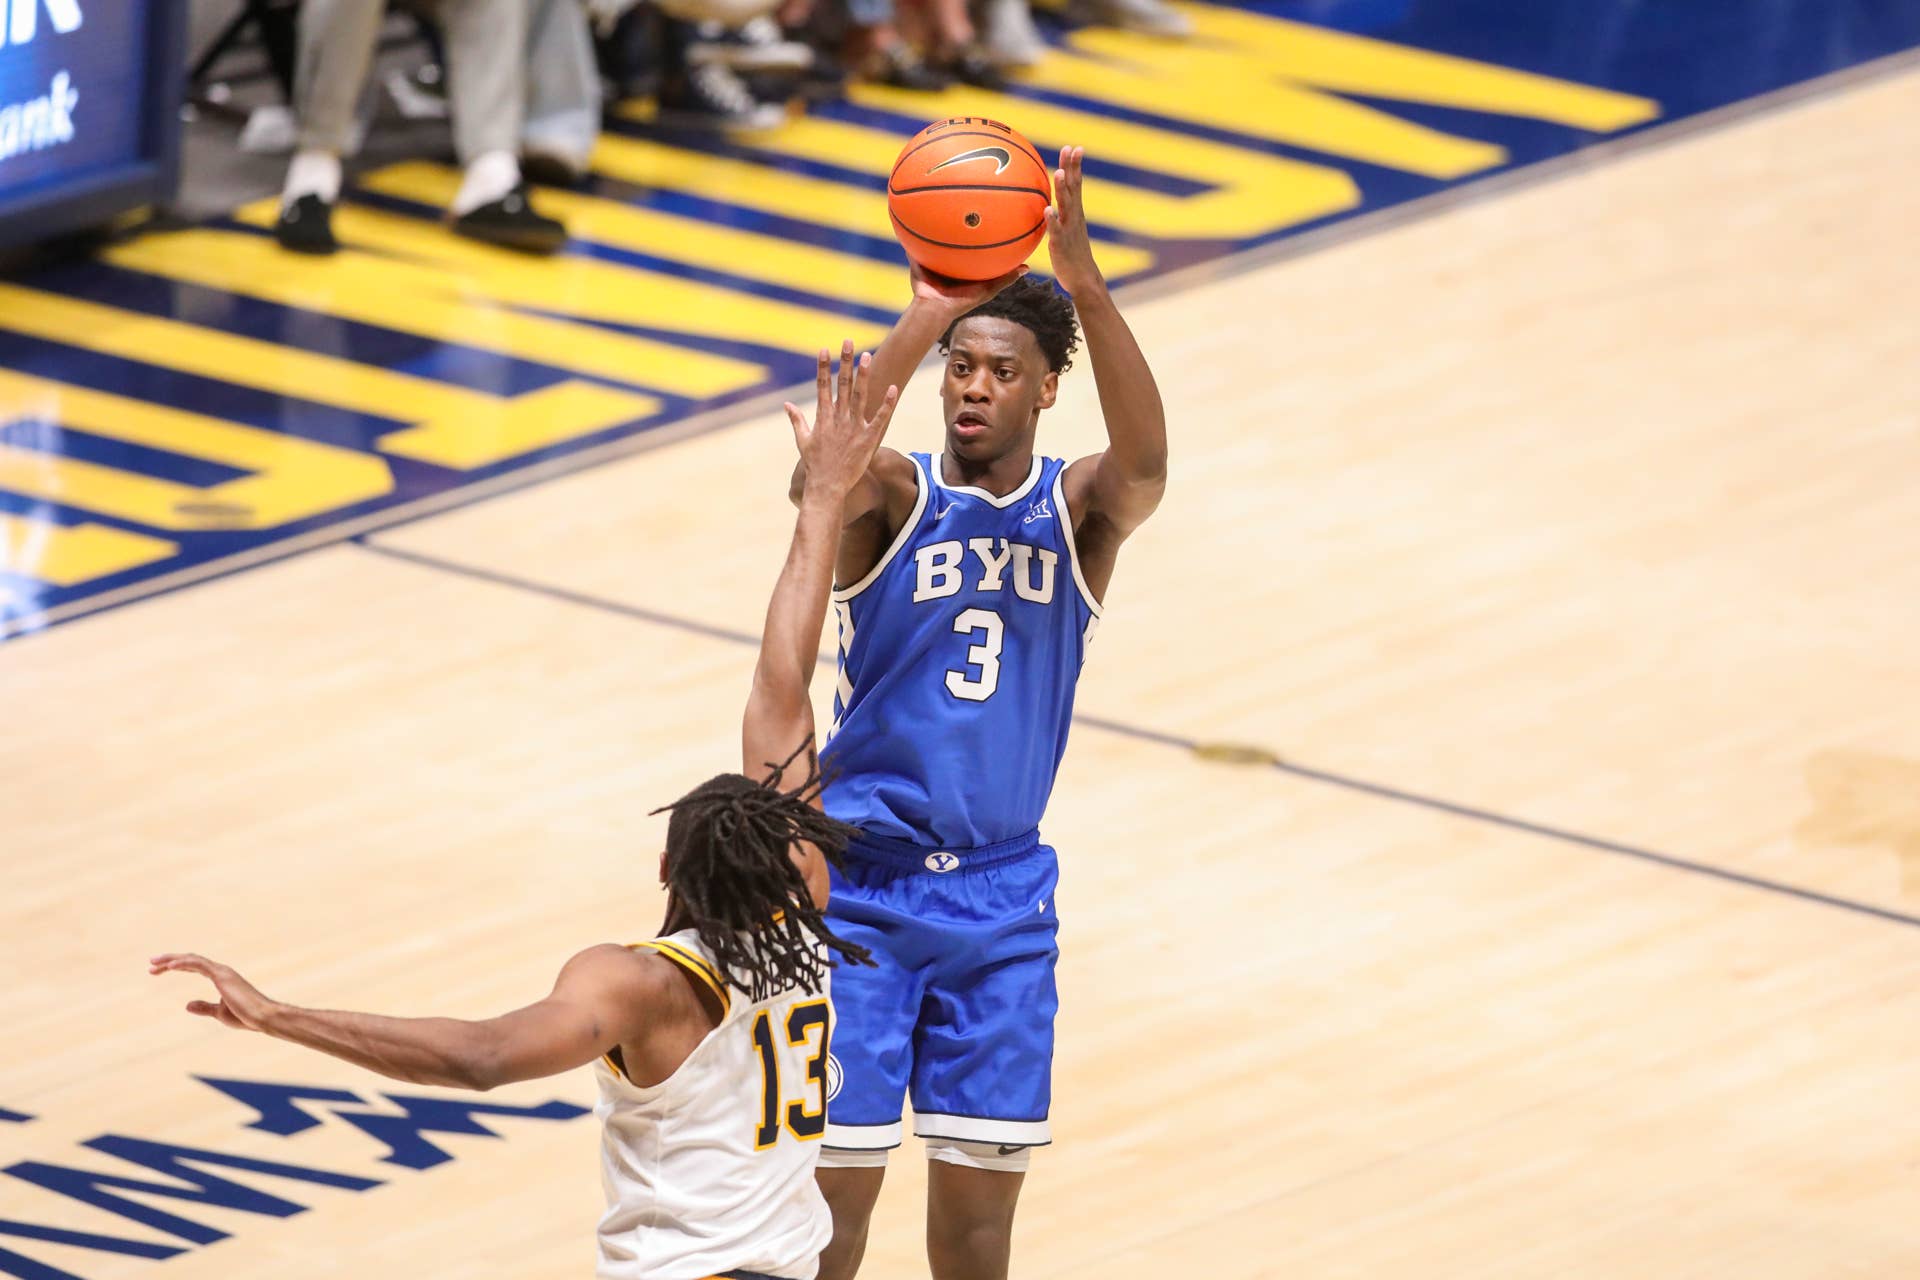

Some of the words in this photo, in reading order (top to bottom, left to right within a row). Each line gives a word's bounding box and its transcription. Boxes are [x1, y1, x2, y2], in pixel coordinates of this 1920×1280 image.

[913, 537, 1058, 604] BYU
[944, 608, 1005, 702] 3
[932, 854, 954, 871] Y
[751, 998, 830, 1152] 13
